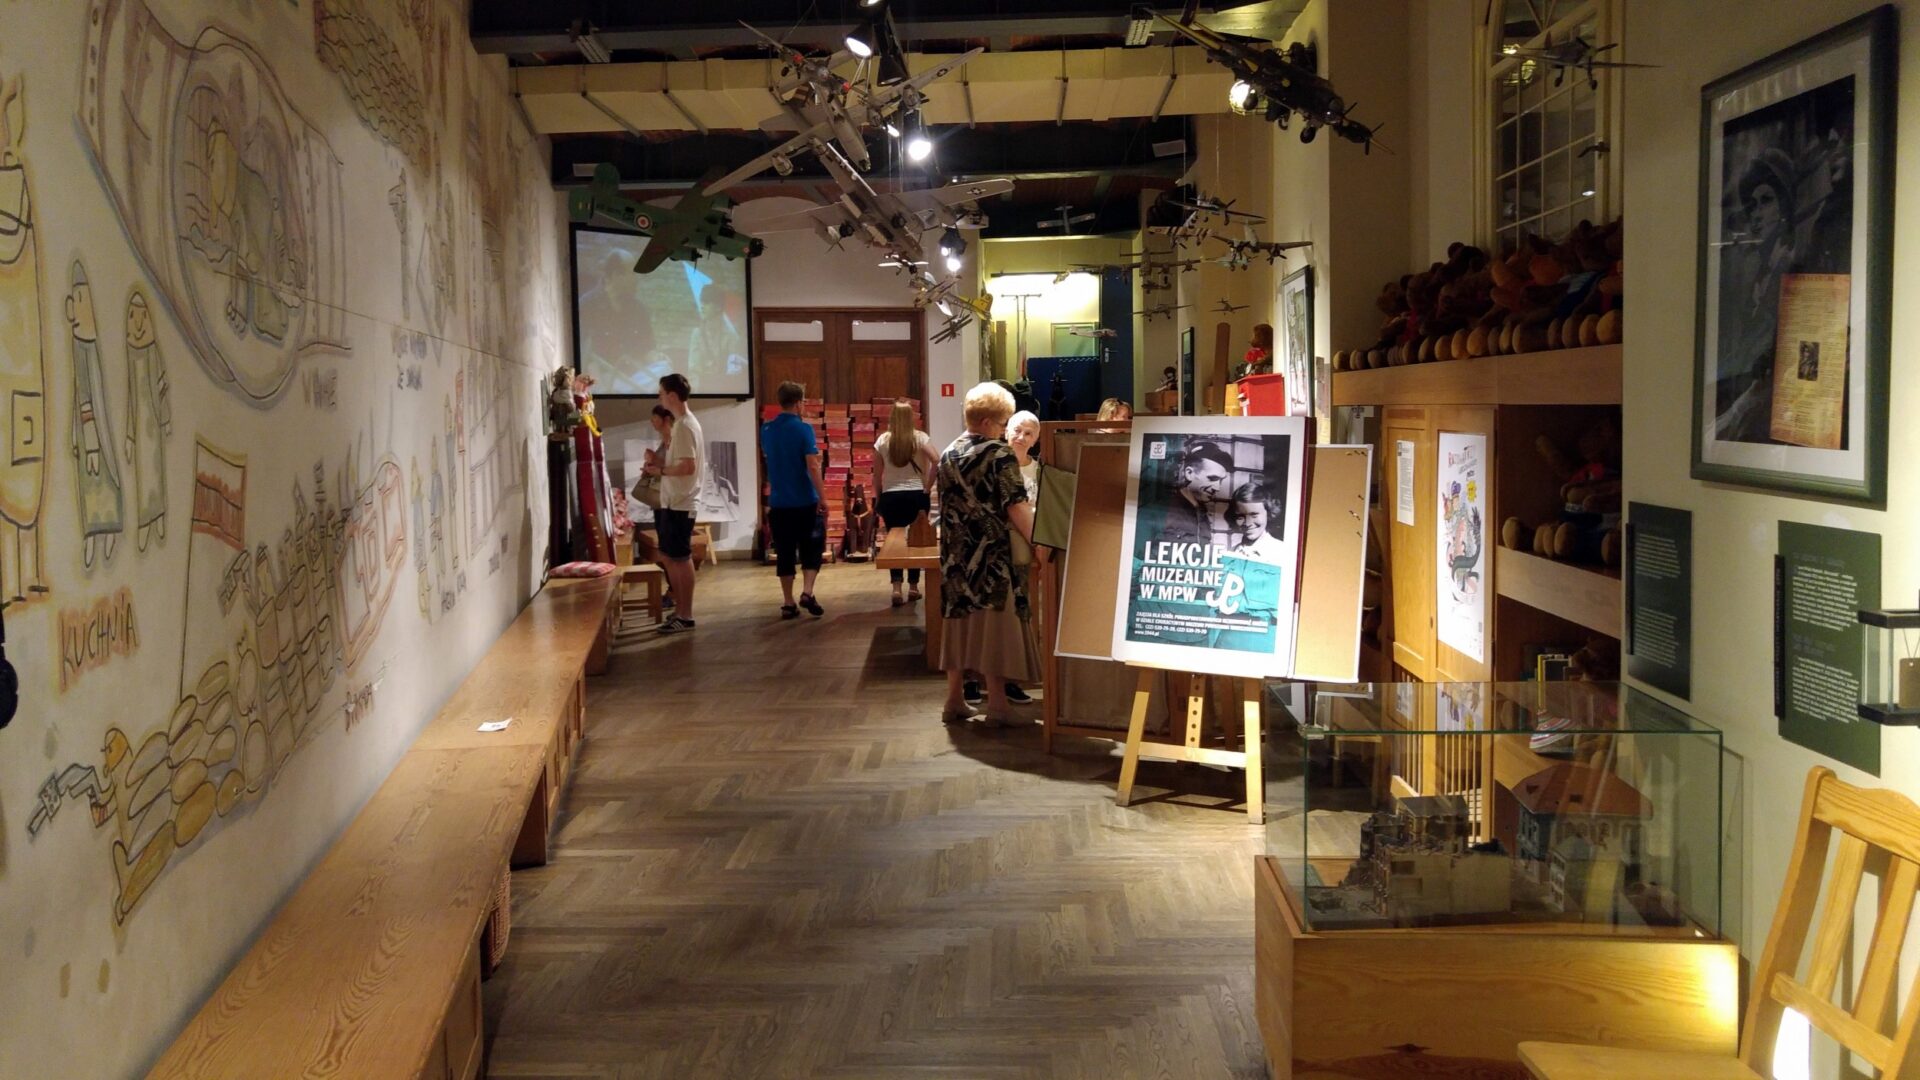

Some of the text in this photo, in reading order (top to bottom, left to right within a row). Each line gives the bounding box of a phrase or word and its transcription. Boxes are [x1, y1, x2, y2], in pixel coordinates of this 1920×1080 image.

[1144, 541, 1226, 569] LEKCJE
[1142, 566, 1224, 587] MUZEALNE
[1140, 584, 1198, 603] W MPW
[61, 593, 138, 688] KUCHNIA
